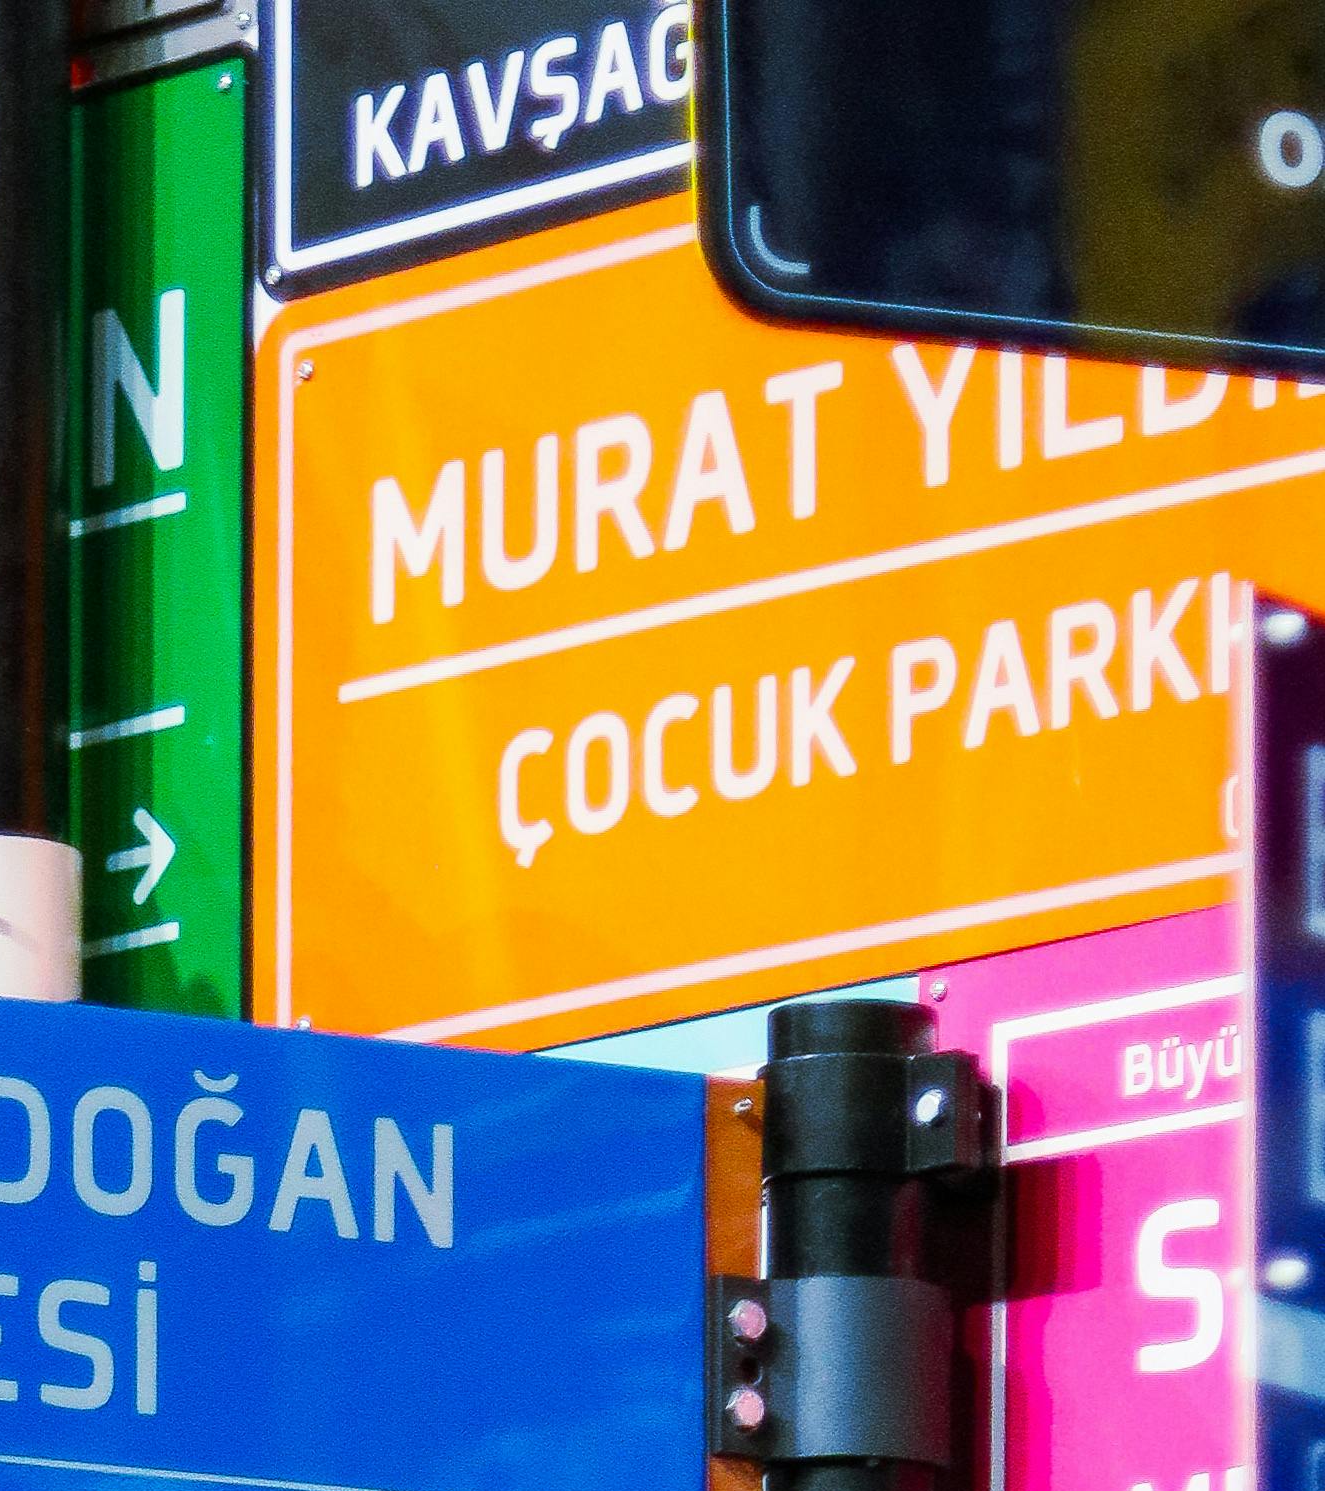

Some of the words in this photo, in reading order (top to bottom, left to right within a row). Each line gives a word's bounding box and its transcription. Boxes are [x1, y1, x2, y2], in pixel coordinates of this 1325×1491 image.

[371, 362, 843, 626] MURAT
[498, 656, 857, 868] ÇOCUK
[887, 571, 1233, 766] PARKI
